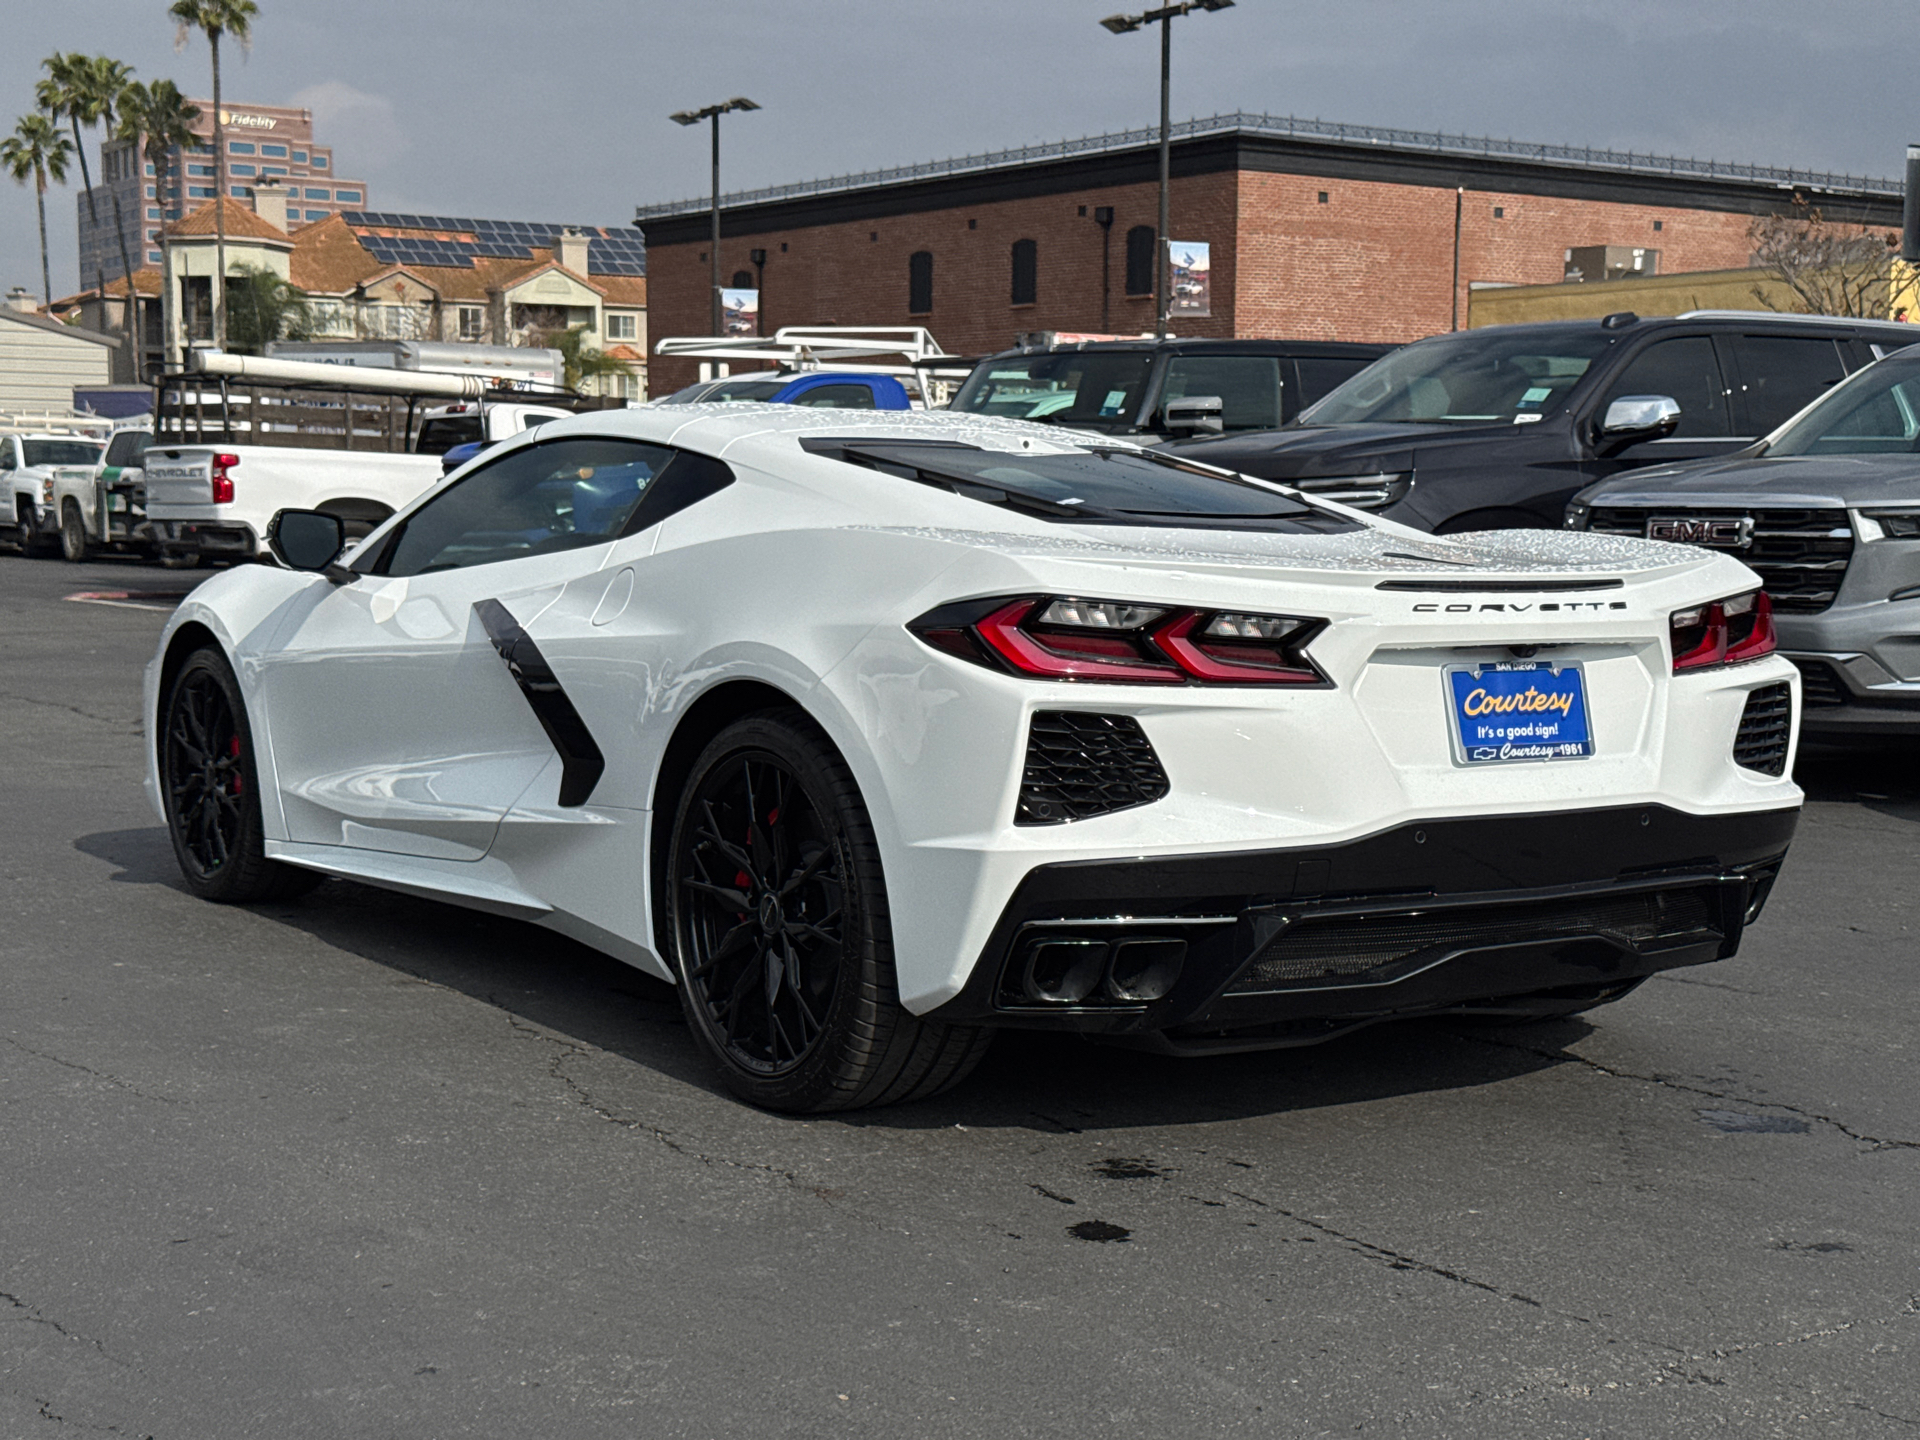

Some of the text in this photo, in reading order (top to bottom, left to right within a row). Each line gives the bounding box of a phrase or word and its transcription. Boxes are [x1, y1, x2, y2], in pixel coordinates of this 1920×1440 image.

[230, 114, 277, 130] Fidelity
[1650, 521, 1740, 542] GMC
[1412, 602, 1627, 612] CORVETTE
[1495, 661, 1537, 671] SAN DIEGO
[1464, 685, 1574, 717] Courtesy
[1477, 722, 1559, 740] It's a good sign!
[1499, 742, 1554, 760] Courtesy
